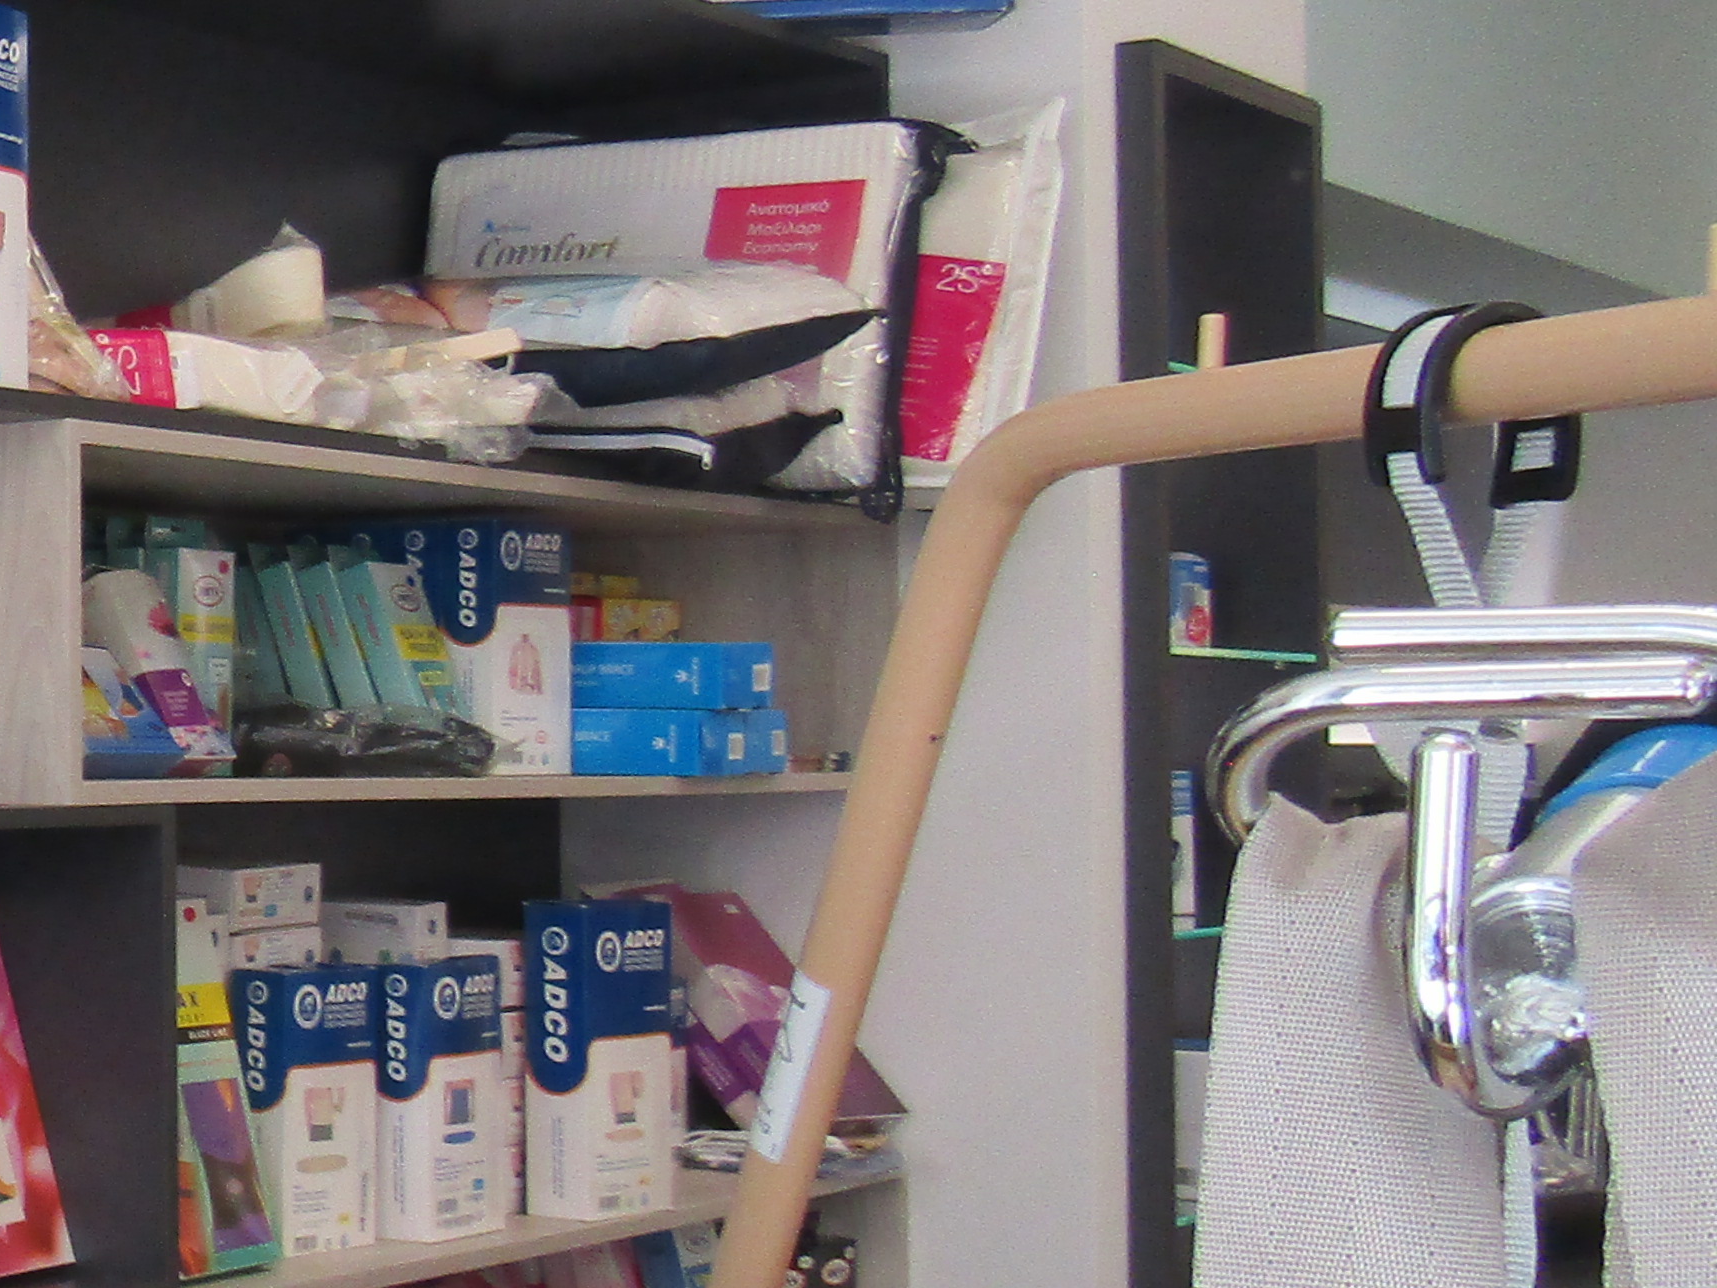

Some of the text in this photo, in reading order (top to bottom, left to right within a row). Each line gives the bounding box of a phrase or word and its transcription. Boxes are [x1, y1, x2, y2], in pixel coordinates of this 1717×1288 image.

[476, 231, 620, 269] Comfort
[524, 532, 562, 552] ADCO
[458, 553, 478, 629] ADCO
[623, 929, 664, 949] ADCO
[324, 982, 367, 1003] ADCO
[541, 966, 567, 1064] ADCO
[245, 1014, 264, 1093] ADCO
[385, 998, 406, 1083] ADCO
